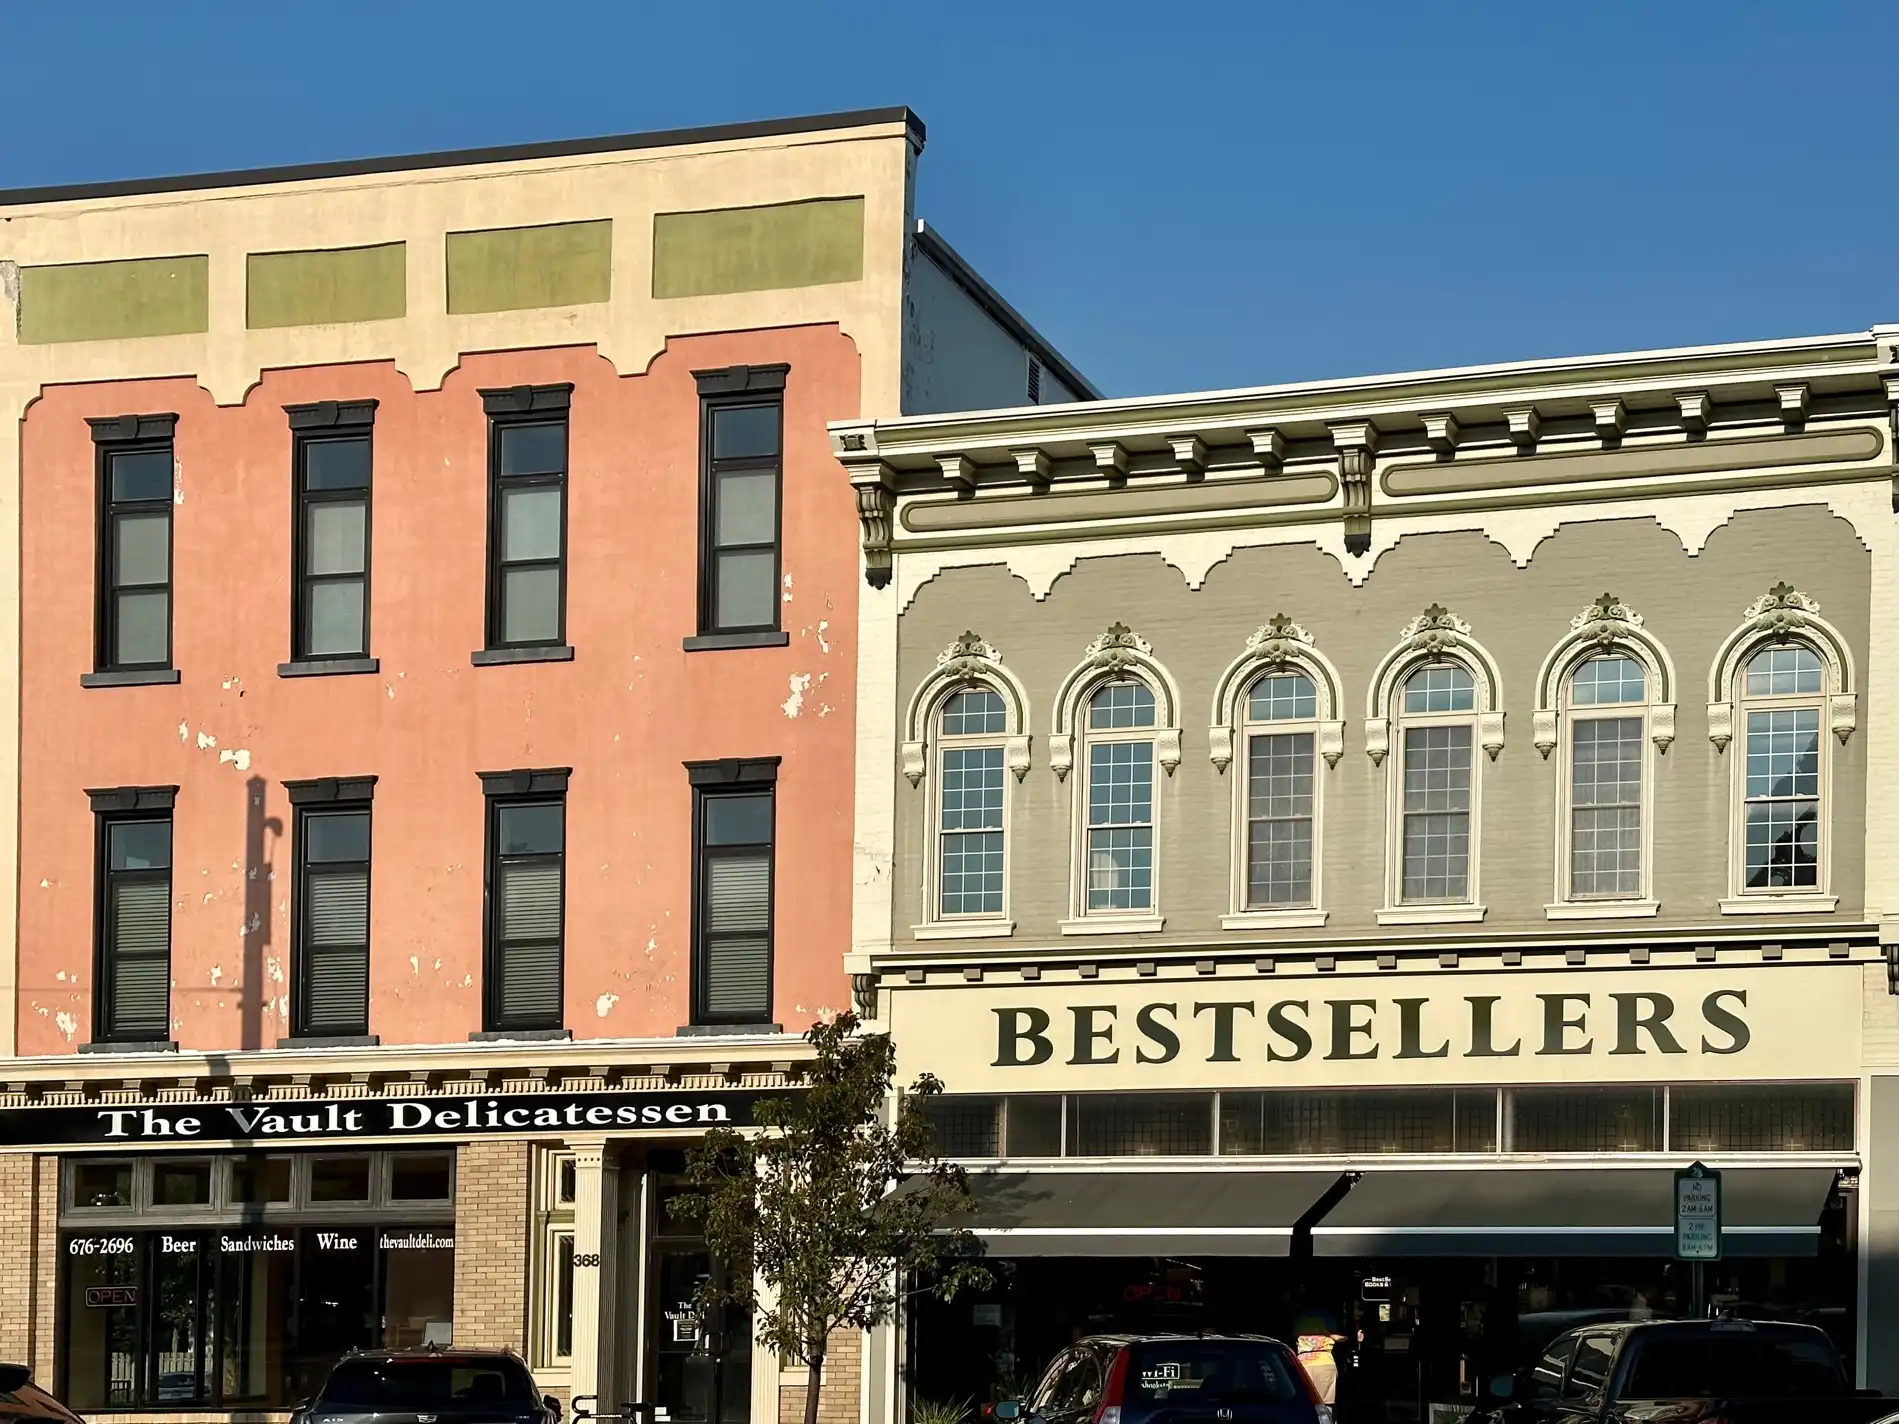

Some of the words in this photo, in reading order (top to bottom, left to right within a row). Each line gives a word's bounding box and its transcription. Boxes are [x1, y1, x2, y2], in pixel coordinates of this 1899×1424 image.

[989, 989, 1751, 1067] BESTSELLERS
[97, 1109, 201, 1137] The
[225, 1103, 363, 1134] Vault
[387, 1099, 732, 1131] Delicatessen
[1692, 1183, 1702, 1192] NO
[1683, 1194, 1711, 1203] PARKING
[1688, 1222, 1694, 1231] 2
[221, 1234, 295, 1252] Sandwiches
[317, 1232, 358, 1250] Wine
[379, 1233, 455, 1249] thevaultdeli.com
[1682, 1232, 1713, 1241] PARKING
[69, 1236, 134, 1255] 676-2696
[162, 1236, 197, 1253] Beer
[574, 1254, 600, 1267] 368
[88, 1289, 136, 1304] OPEN
[677, 1301, 693, 1309] The
[664, 1310, 686, 1320] Vault
[687, 1310, 705, 1320] Dli
